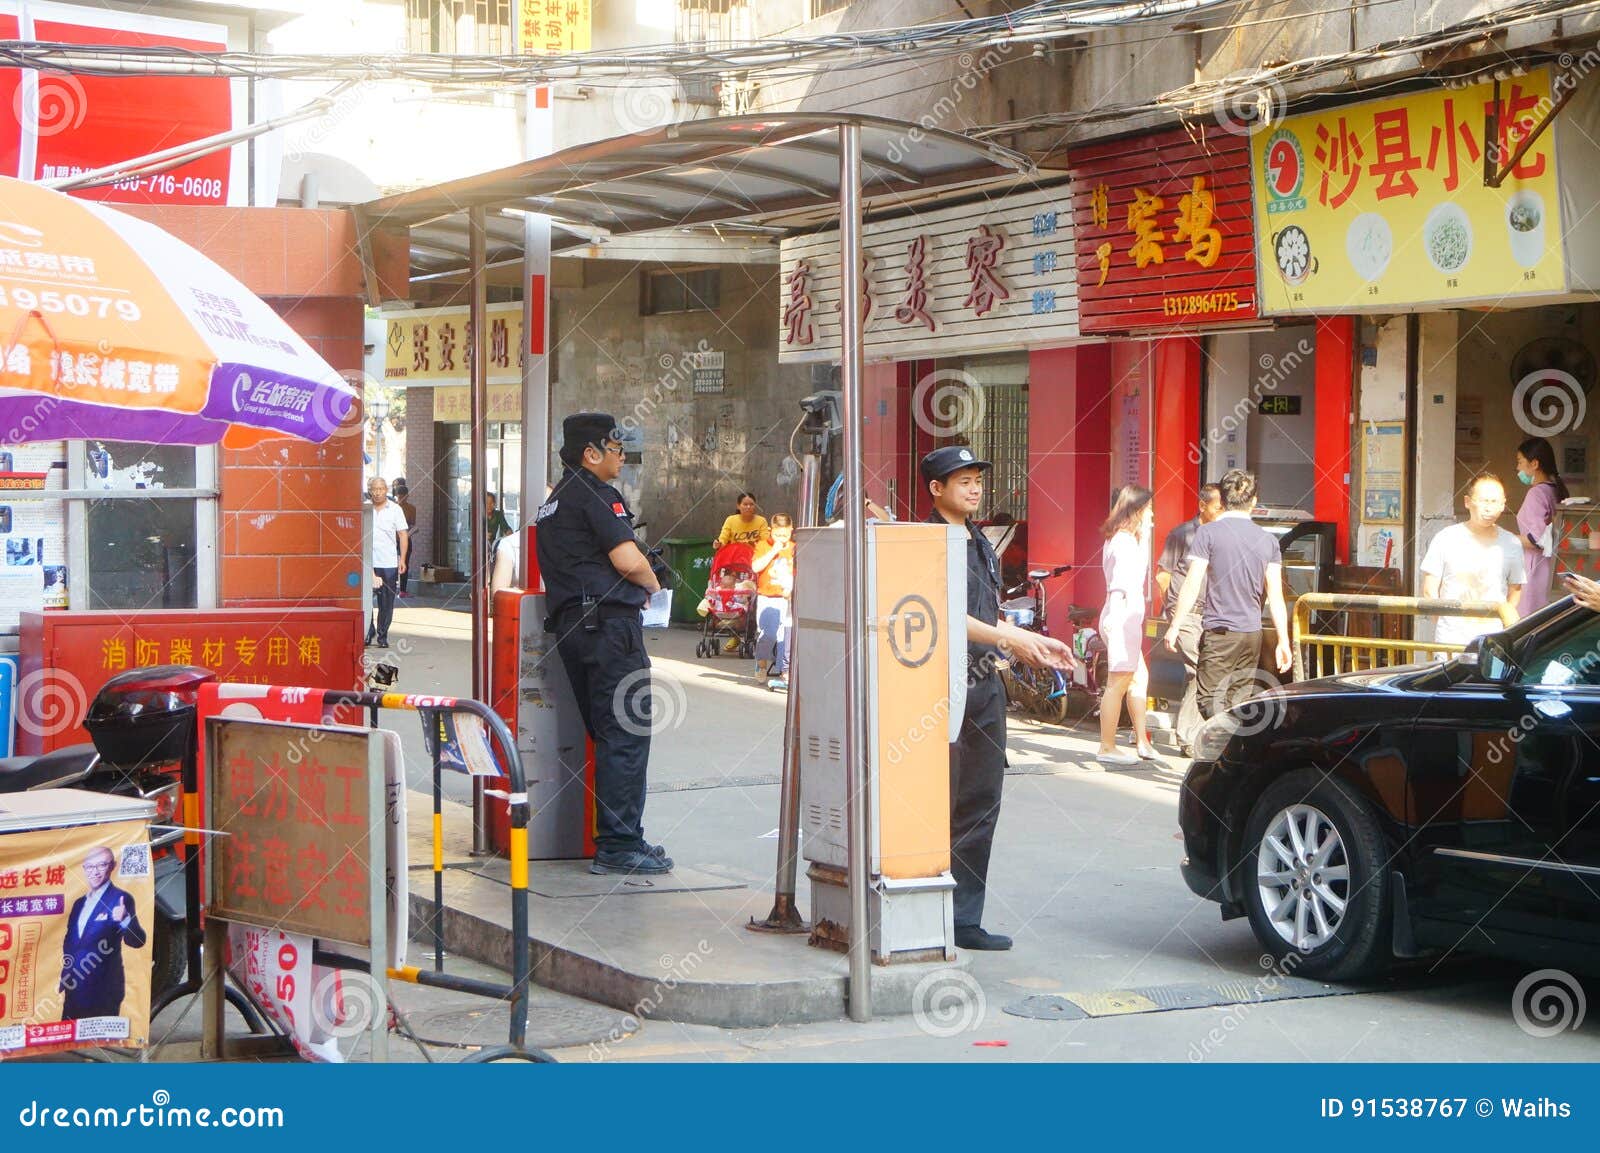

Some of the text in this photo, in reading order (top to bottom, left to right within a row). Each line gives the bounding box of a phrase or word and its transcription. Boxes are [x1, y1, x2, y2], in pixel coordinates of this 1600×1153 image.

[1313, 84, 1546, 210] 沙县小吃
[12, 287, 142, 322] 95079
[1164, 293, 1239, 316] 13128964725
[102, 636, 323, 669] 消防器材专用箱
[229, 748, 366, 828] 电力施工
[226, 830, 366, 919] 注意安全
[1, 897, 58, 914] 长城宽带
